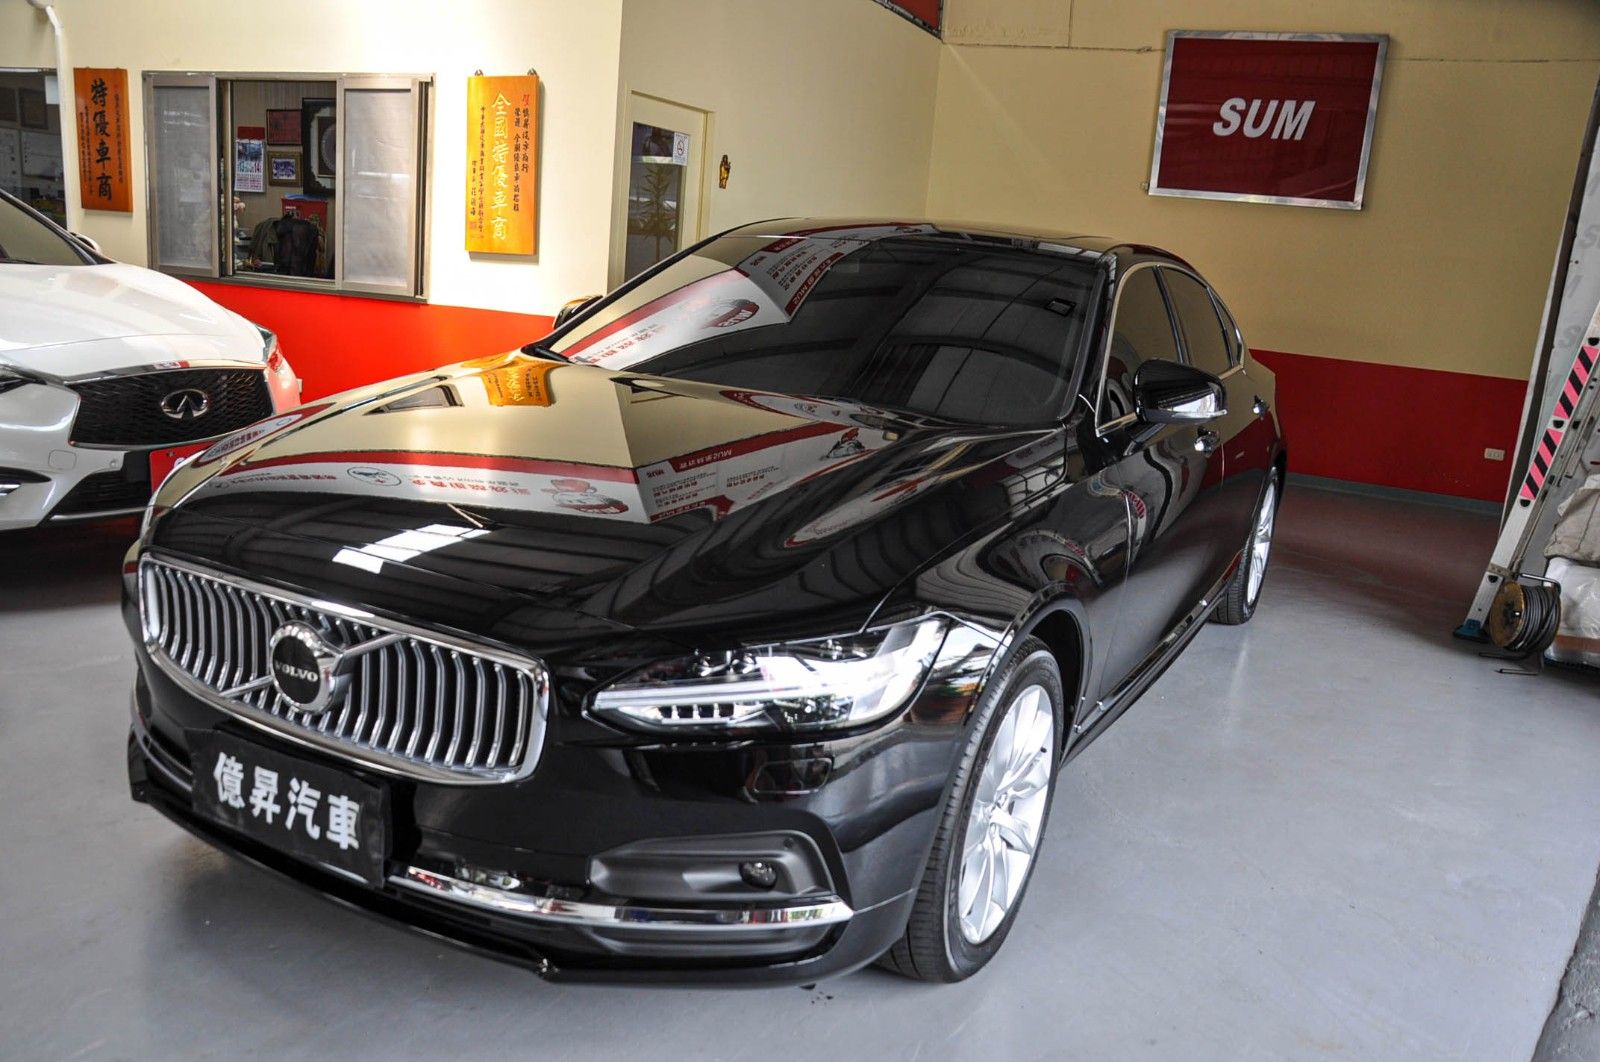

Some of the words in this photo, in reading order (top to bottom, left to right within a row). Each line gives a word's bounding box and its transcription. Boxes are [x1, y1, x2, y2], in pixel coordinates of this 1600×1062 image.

[90, 78, 113, 200] 特優車商
[490, 92, 512, 240] 全國特優車商
[1212, 97, 1316, 141] SUM
[275, 663, 319, 683] VOLVO
[213, 752, 361, 850] 億昇汽車
